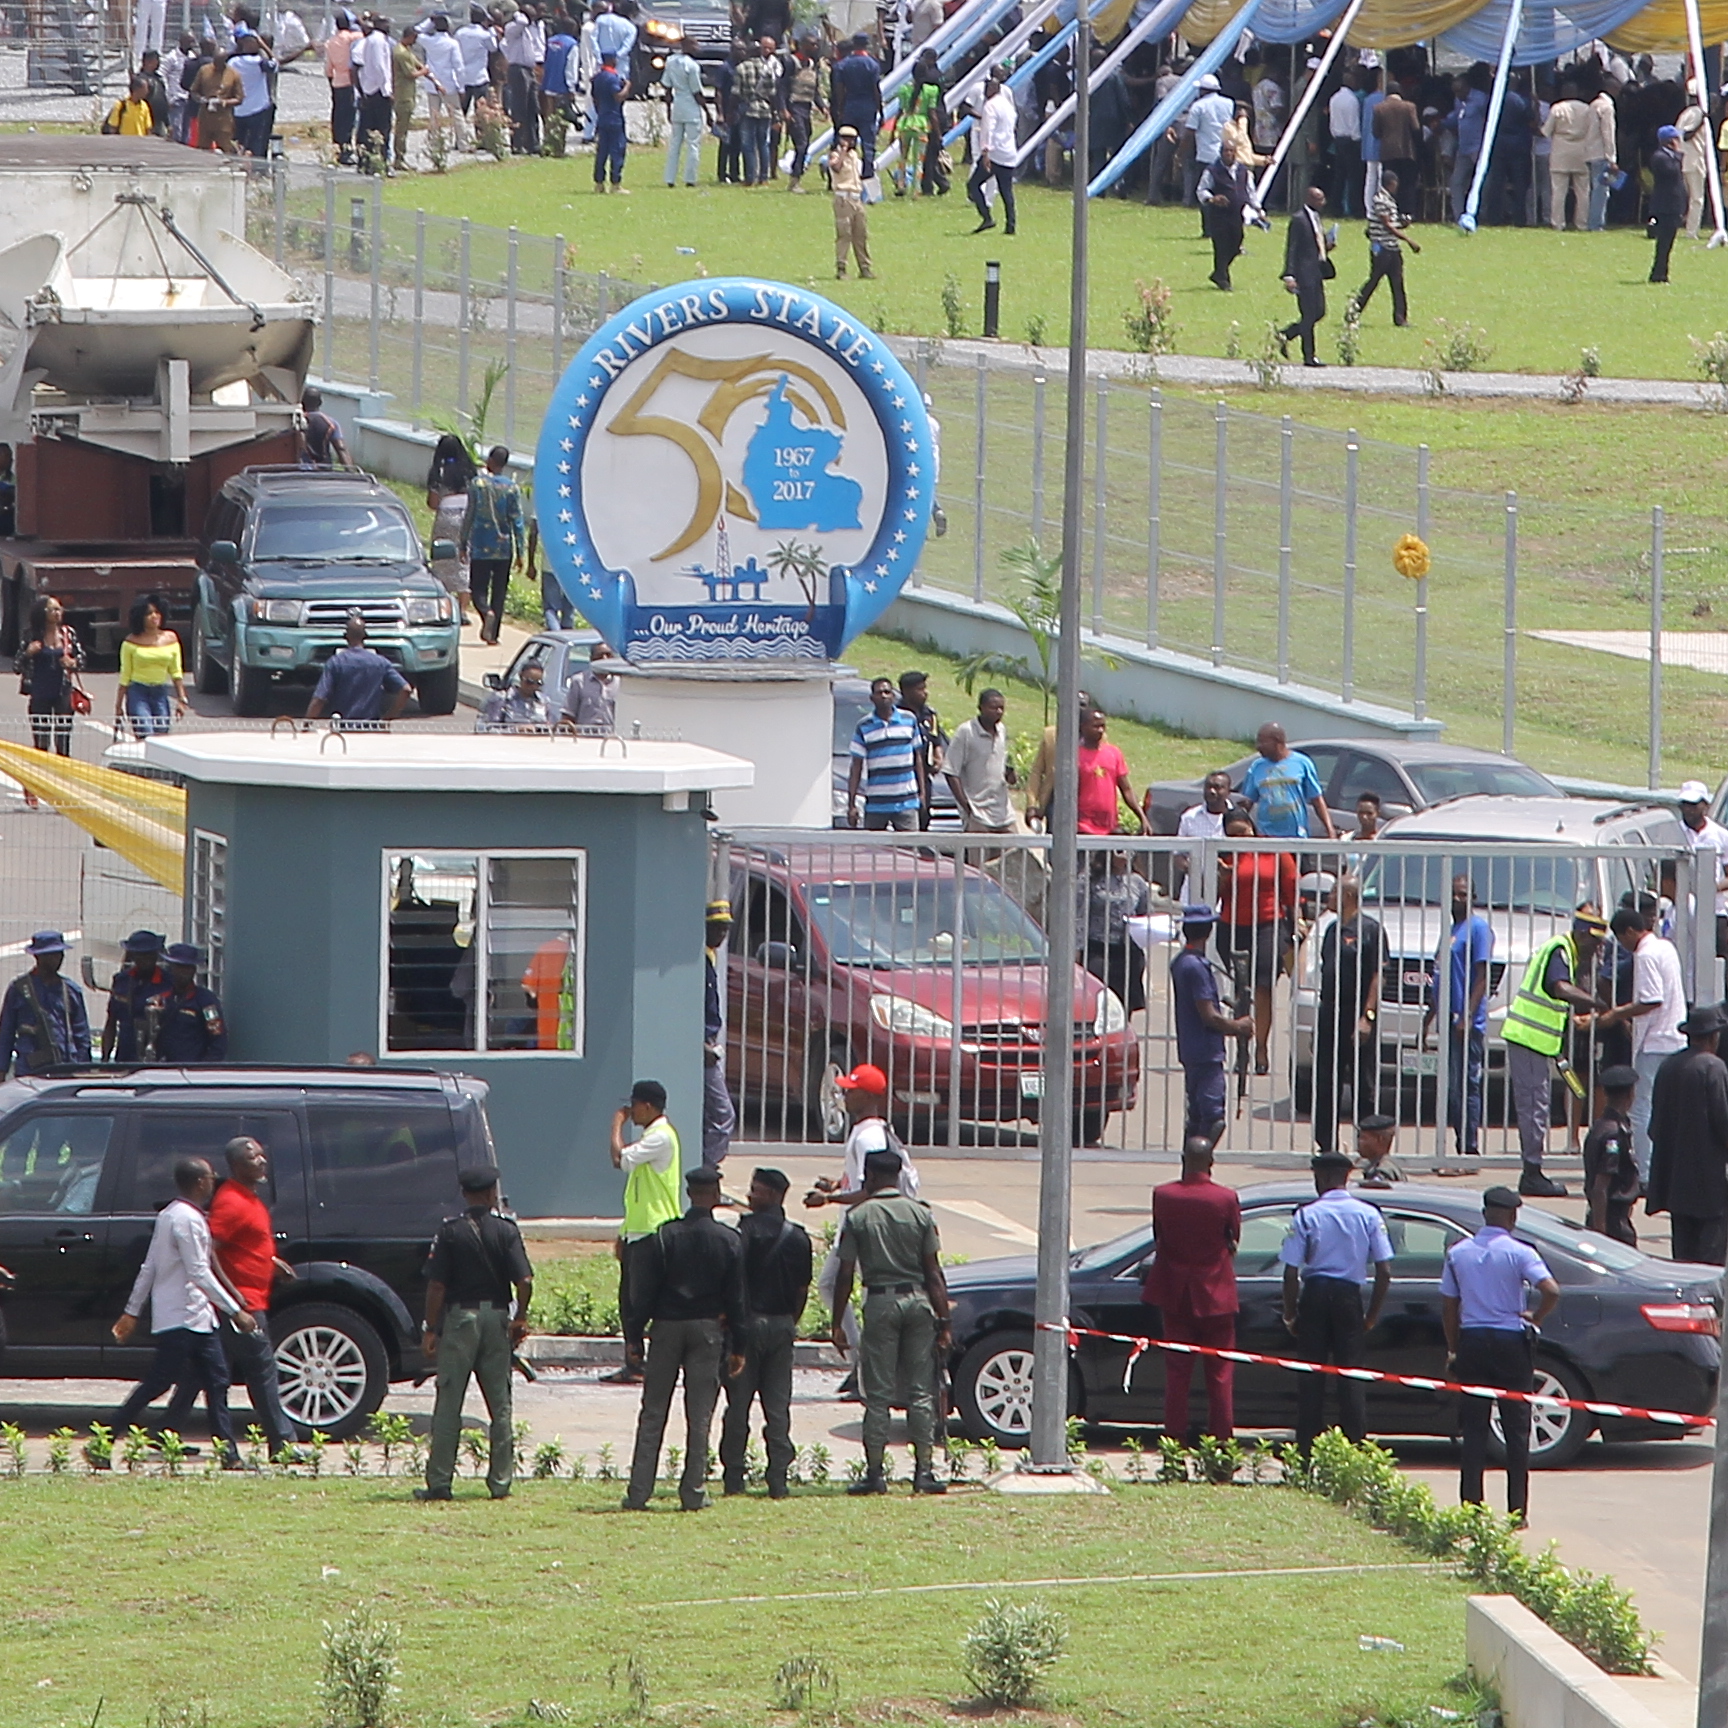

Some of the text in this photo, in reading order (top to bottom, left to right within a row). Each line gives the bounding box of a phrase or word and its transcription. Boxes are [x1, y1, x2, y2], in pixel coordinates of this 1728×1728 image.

[590, 289, 873, 380] RIVERS STATE
[773, 447, 815, 467] 1967
[789, 467, 801, 478] to
[772, 480, 816, 502] 2017
[686, 613, 739, 636] Proud
[742, 614, 810, 639] Heritage
